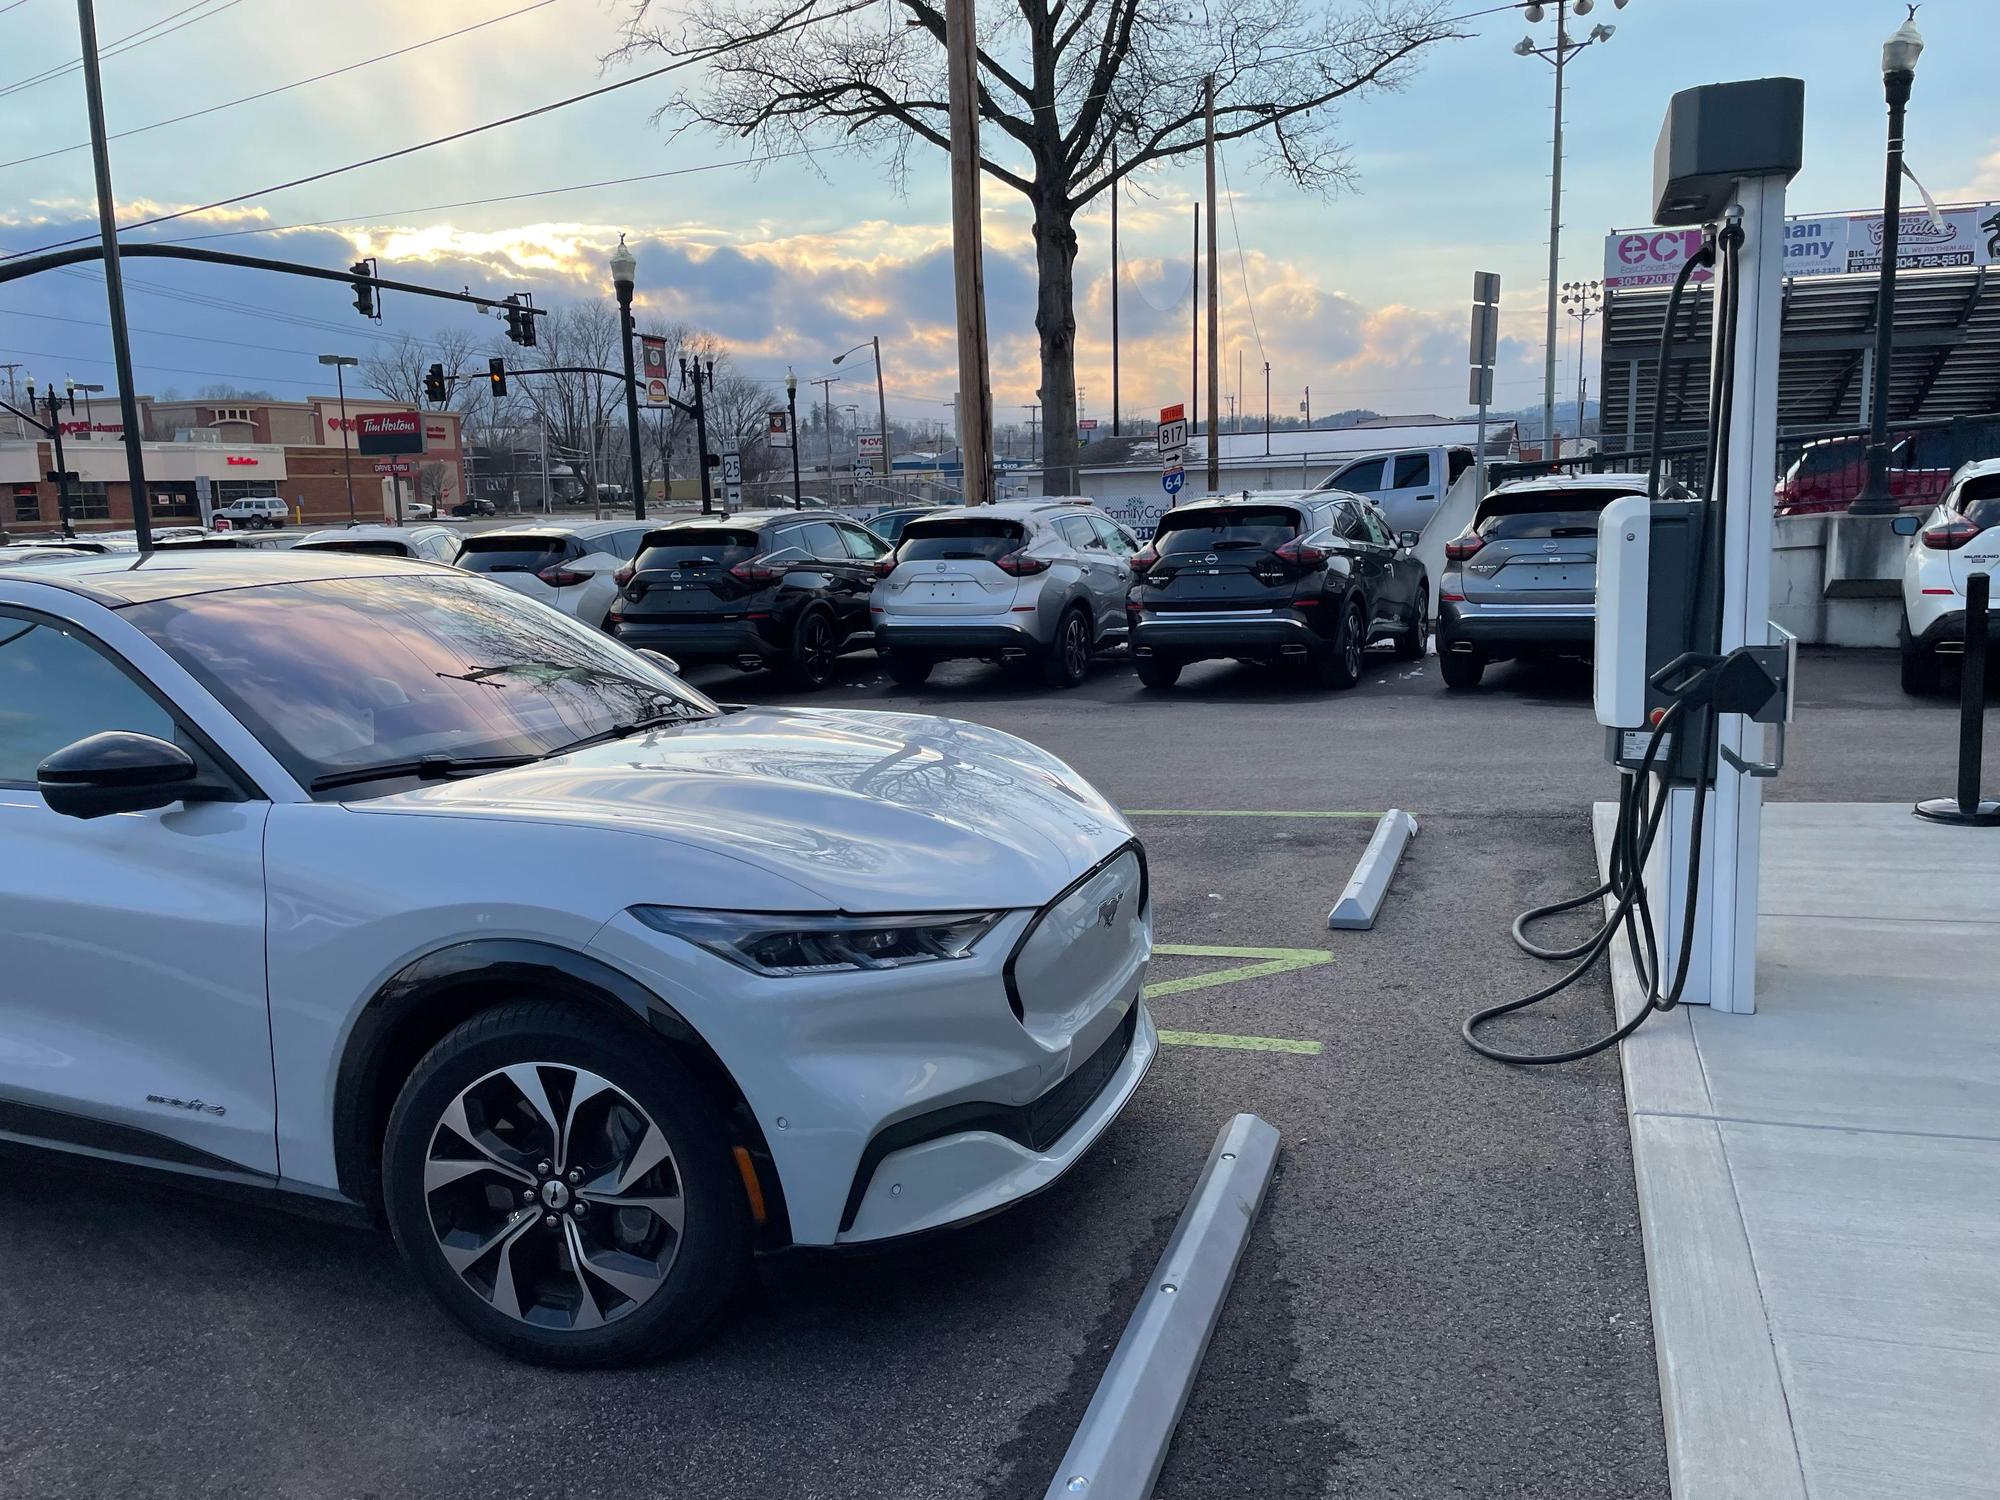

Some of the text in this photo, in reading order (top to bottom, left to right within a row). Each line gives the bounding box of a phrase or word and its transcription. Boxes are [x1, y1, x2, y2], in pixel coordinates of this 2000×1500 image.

[1783, 241, 1834, 259] any
[1619, 273, 1694, 287] 304.720.87
[340, 419, 357, 432] CV
[363, 417, 415, 433] Tim Hortons
[1162, 426, 1183, 444] 817
[726, 442, 736, 450] TO
[374, 463, 408, 472] DRIVE THRU
[725, 461, 740, 478] 25
[1165, 473, 1182, 490] 64
